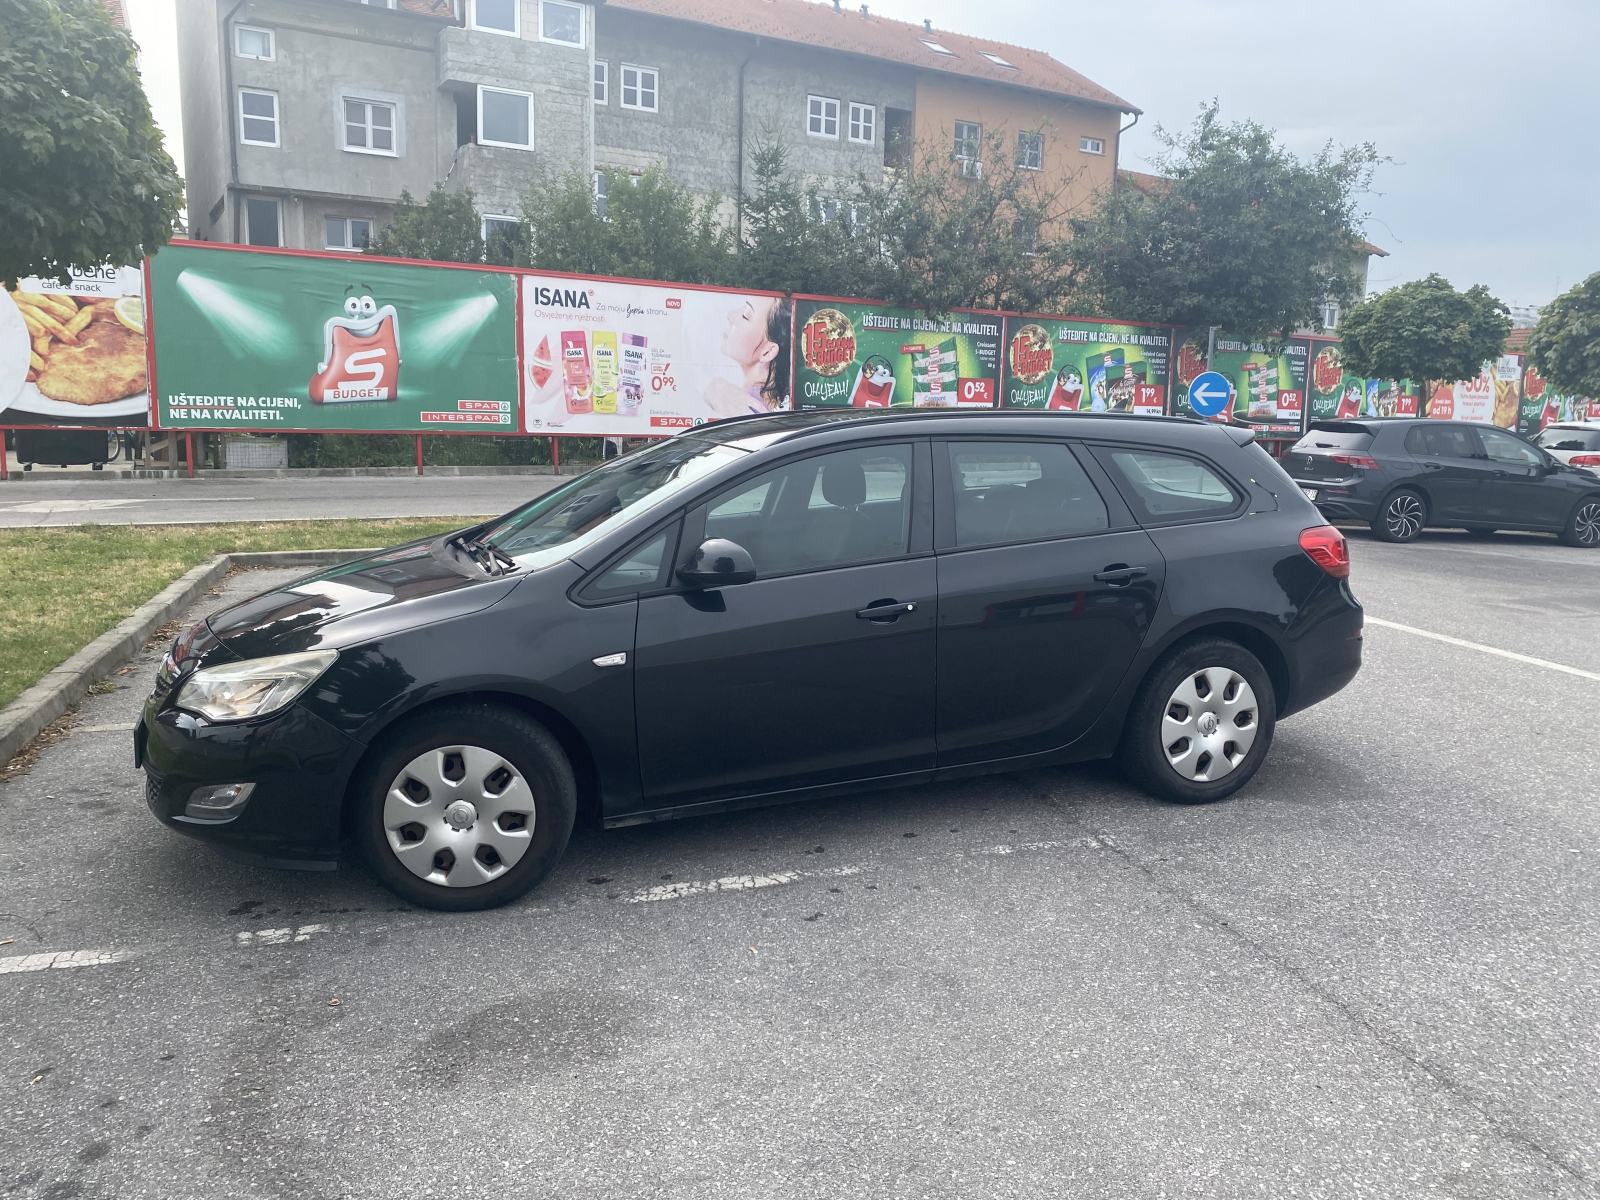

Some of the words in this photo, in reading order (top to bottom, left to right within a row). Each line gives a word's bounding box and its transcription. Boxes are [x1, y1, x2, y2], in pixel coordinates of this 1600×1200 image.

[75, 283, 102, 292] snack
[534, 287, 590, 309] ISANA
[863, 313, 898, 328] UŠTEDITE
[900, 318, 910, 330] NA
[912, 318, 938, 332] CIJENI,
[952, 322, 962, 333] NA
[964, 324, 998, 336] KVALITETI.
[804, 322, 827, 355] 15
[1059, 328, 1088, 342] UŠTEDITE
[1089, 332, 1098, 342] NA
[1099, 332, 1120, 344] CIJENI,
[1122, 334, 1129, 344] NE
[1130, 334, 1138, 344] NA
[1140, 336, 1168, 346] KVALITETI.
[624, 350, 642, 359] ISANA
[168, 392, 235, 406] UŠTEDITE
[237, 396, 256, 406] NA
[258, 397, 302, 409] CIJENI,
[333, 388, 382, 399] BUDGET
[170, 408, 188, 418] NE
[190, 409, 211, 419] NA
[214, 410, 284, 420] KVALITETI.
